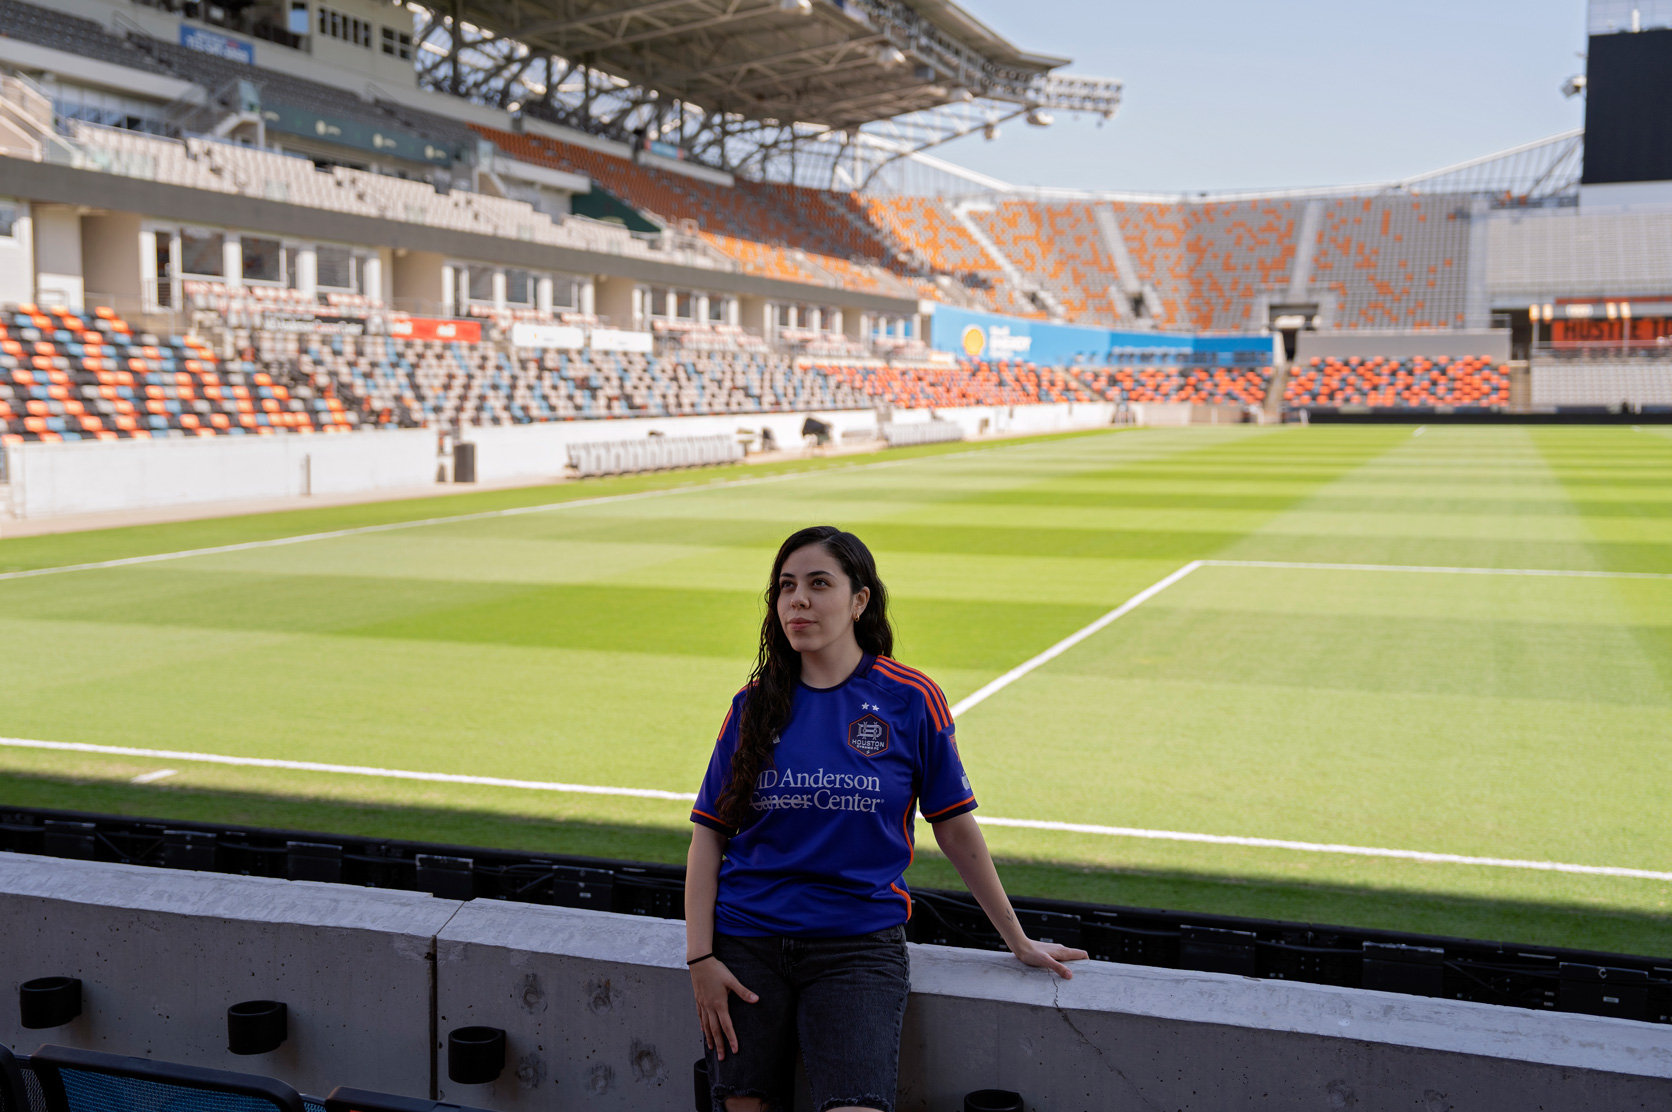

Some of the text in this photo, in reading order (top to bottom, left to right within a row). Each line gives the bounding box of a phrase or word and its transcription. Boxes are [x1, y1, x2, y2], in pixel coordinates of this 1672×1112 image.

[851, 739, 885, 748] HOUSTON
[778, 768, 880, 791] Anderson
[750, 789, 880, 812] Cancer Center
